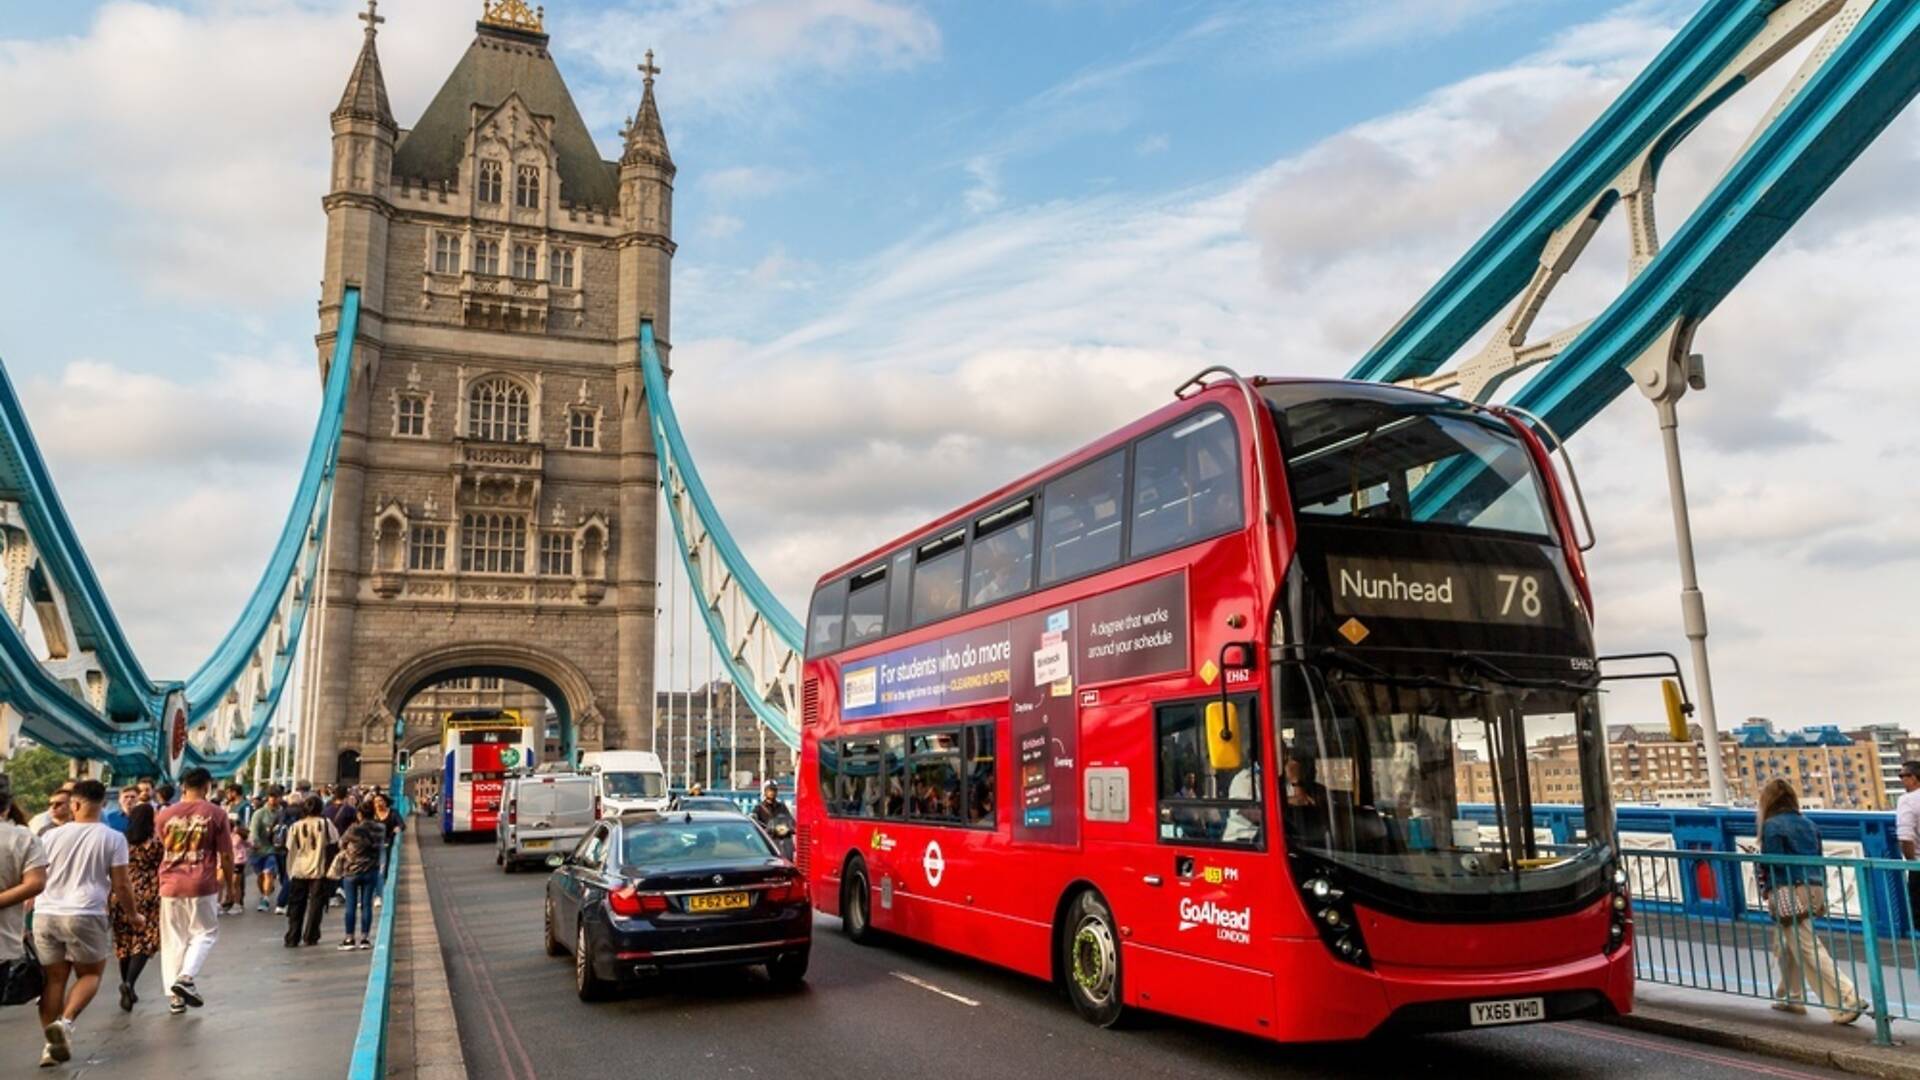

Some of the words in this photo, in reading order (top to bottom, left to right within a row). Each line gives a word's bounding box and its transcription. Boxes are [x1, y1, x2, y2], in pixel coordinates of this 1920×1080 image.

[1340, 568, 1453, 604] Nunhead
[1497, 574, 1542, 617] 78
[1090, 622, 1097, 637] A
[1098, 619, 1124, 638] degree
[1125, 614, 1141, 629] that
[1142, 607, 1169, 625] works
[1088, 640, 1114, 658] around
[1115, 639, 1134, 656] your
[1134, 629, 1174, 650] schedule
[880, 664, 895, 685] For
[897, 656, 937, 682] students
[938, 648, 960, 672] who
[962, 643, 977, 668] do
[978, 640, 1011, 664] more
[989, 669, 1009, 684] OPEN
[691, 894, 721, 909] LF62
[1179, 897, 1251, 931] GoAhead
[1216, 928, 1251, 944] LONDON
[1475, 1003, 1511, 1021] YX66
[1514, 1000, 1539, 1018] WHD
